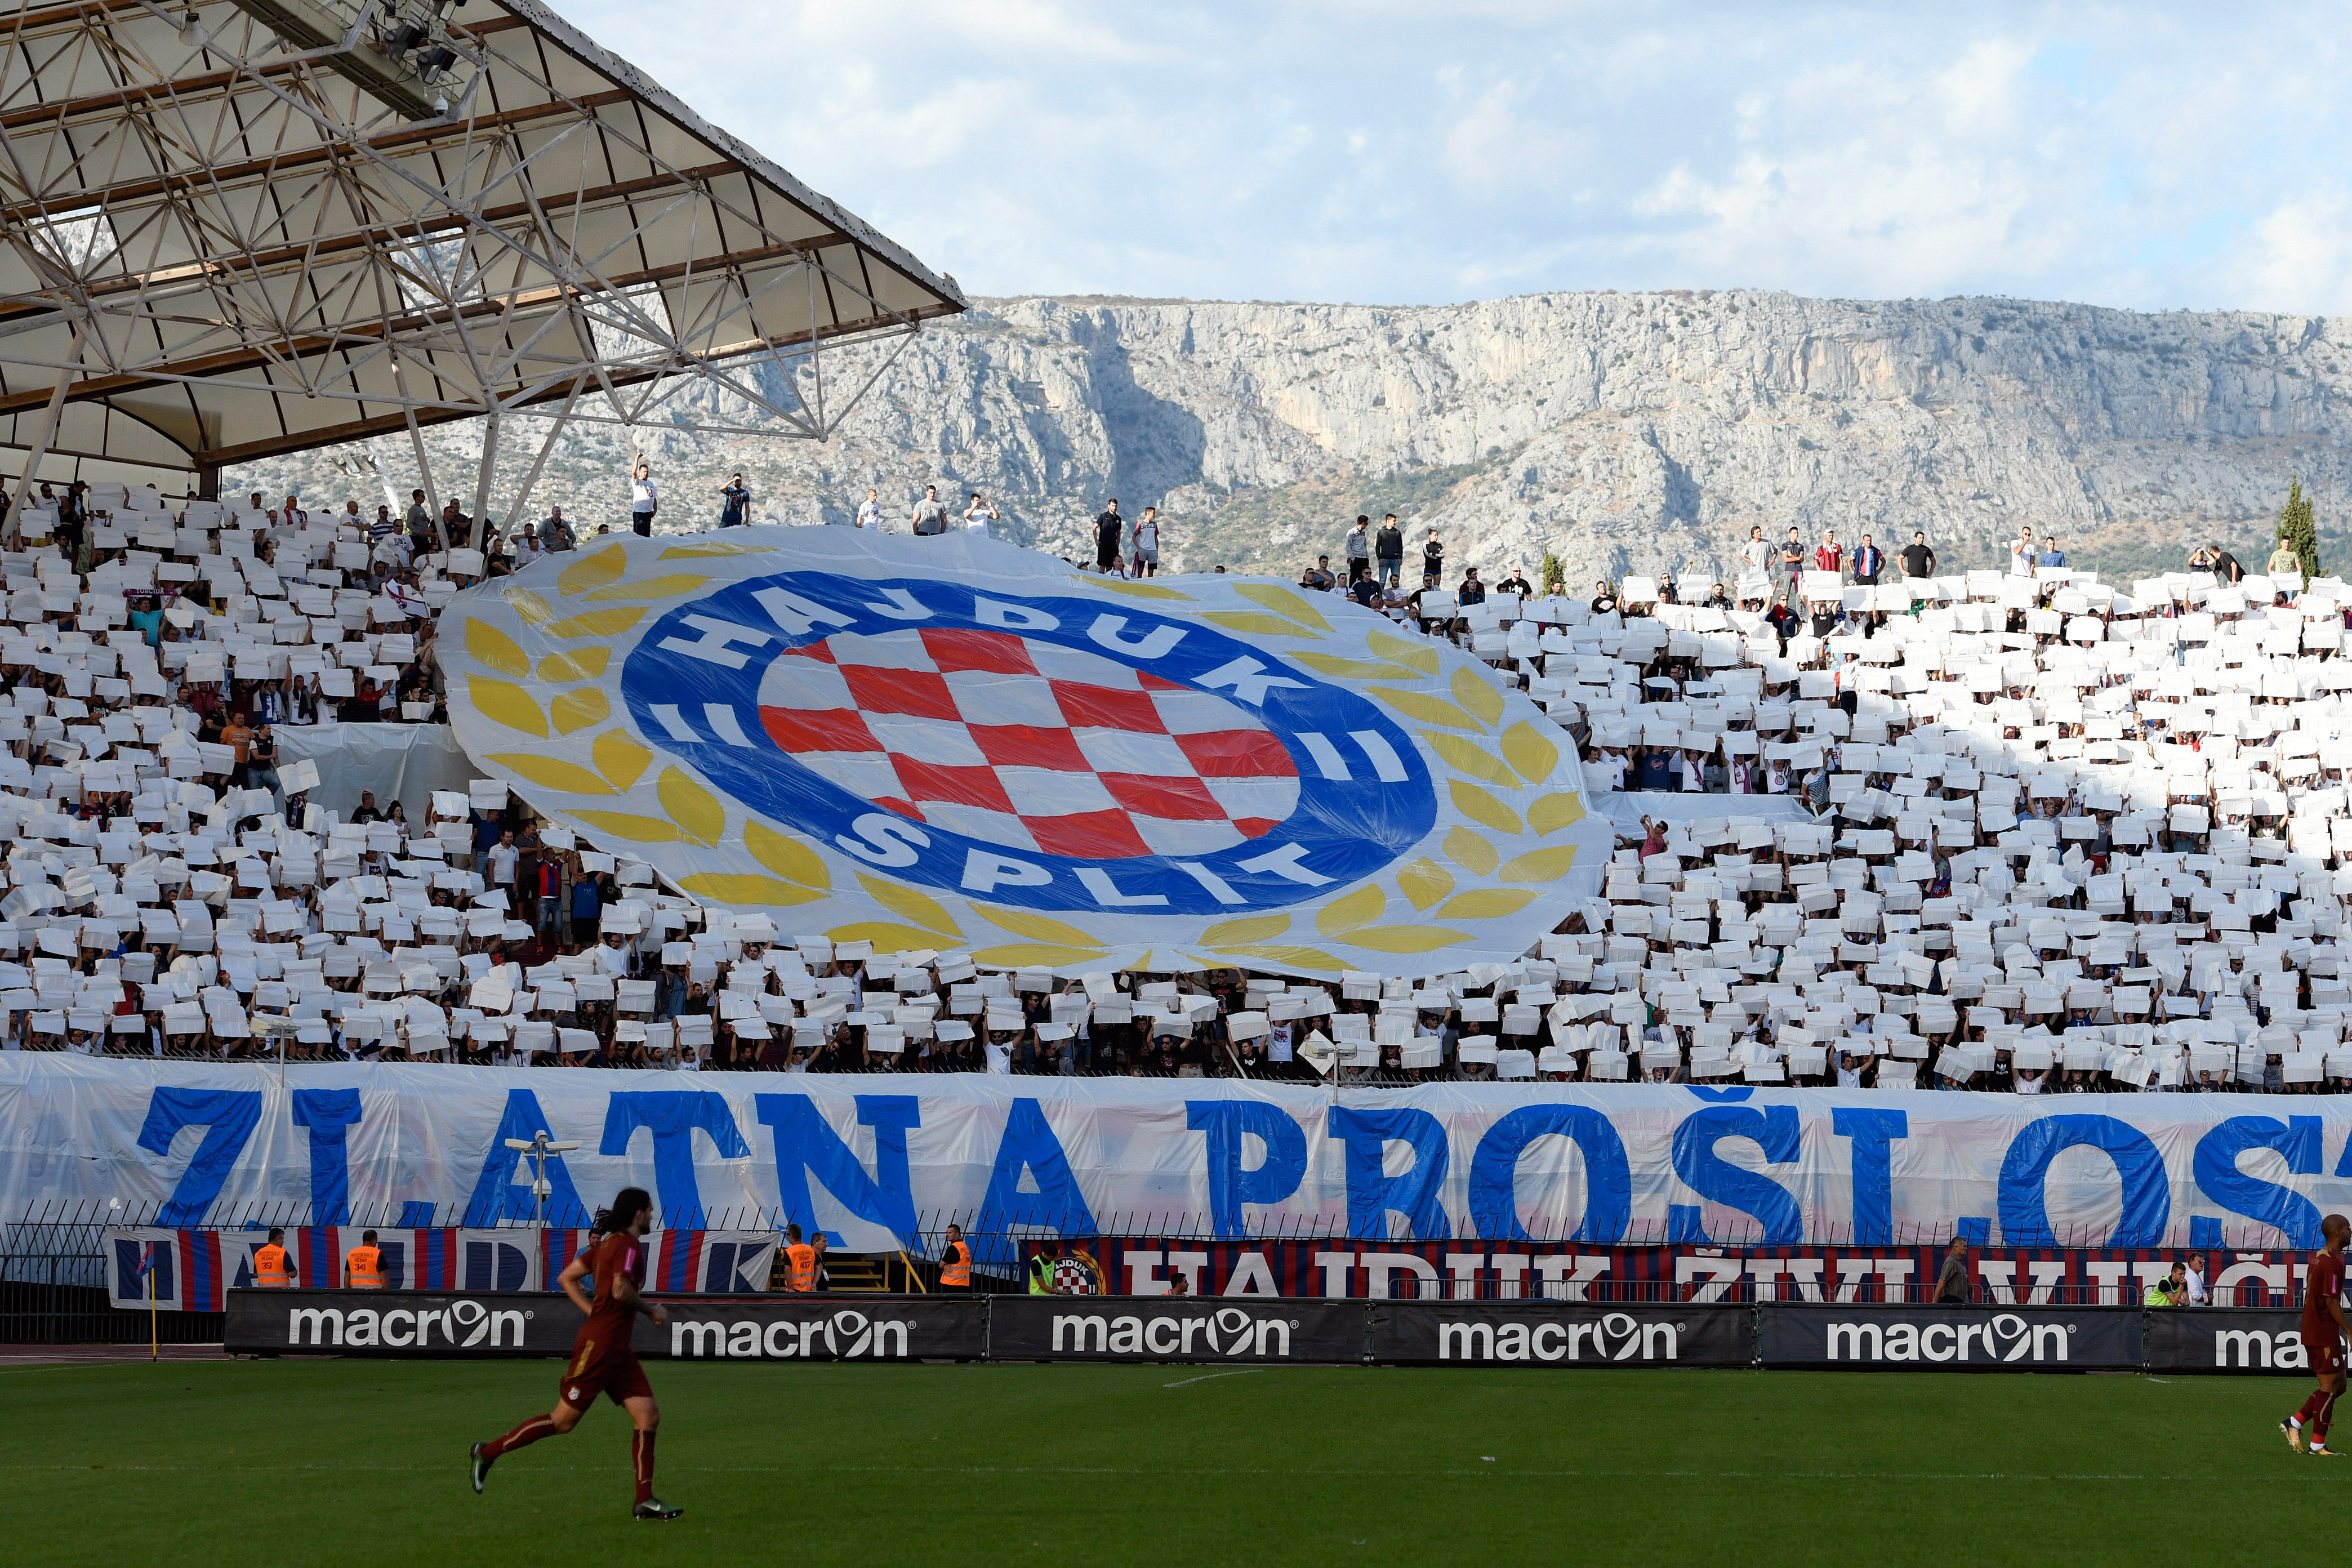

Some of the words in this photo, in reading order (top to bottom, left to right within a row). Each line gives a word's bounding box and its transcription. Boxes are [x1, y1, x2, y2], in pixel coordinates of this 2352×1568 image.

[656, 587, 1315, 708] HAJDUK
[835, 813, 1338, 906] SPLIT
[1185, 1085, 2352, 1248] PROŠLOS
[800, 1261, 811, 1269] 407
[1055, 1259, 1089, 1276] AJDUK
[1124, 1250, 1611, 1301] HAJDUK
[1676, 1248, 1914, 1304] ŽIVI
[289, 1300, 524, 1347] macron
[671, 1311, 907, 1357] macron
[1052, 1308, 1290, 1356] macron
[1440, 1313, 1677, 1361] macron
[1827, 1314, 2068, 1362] macron
